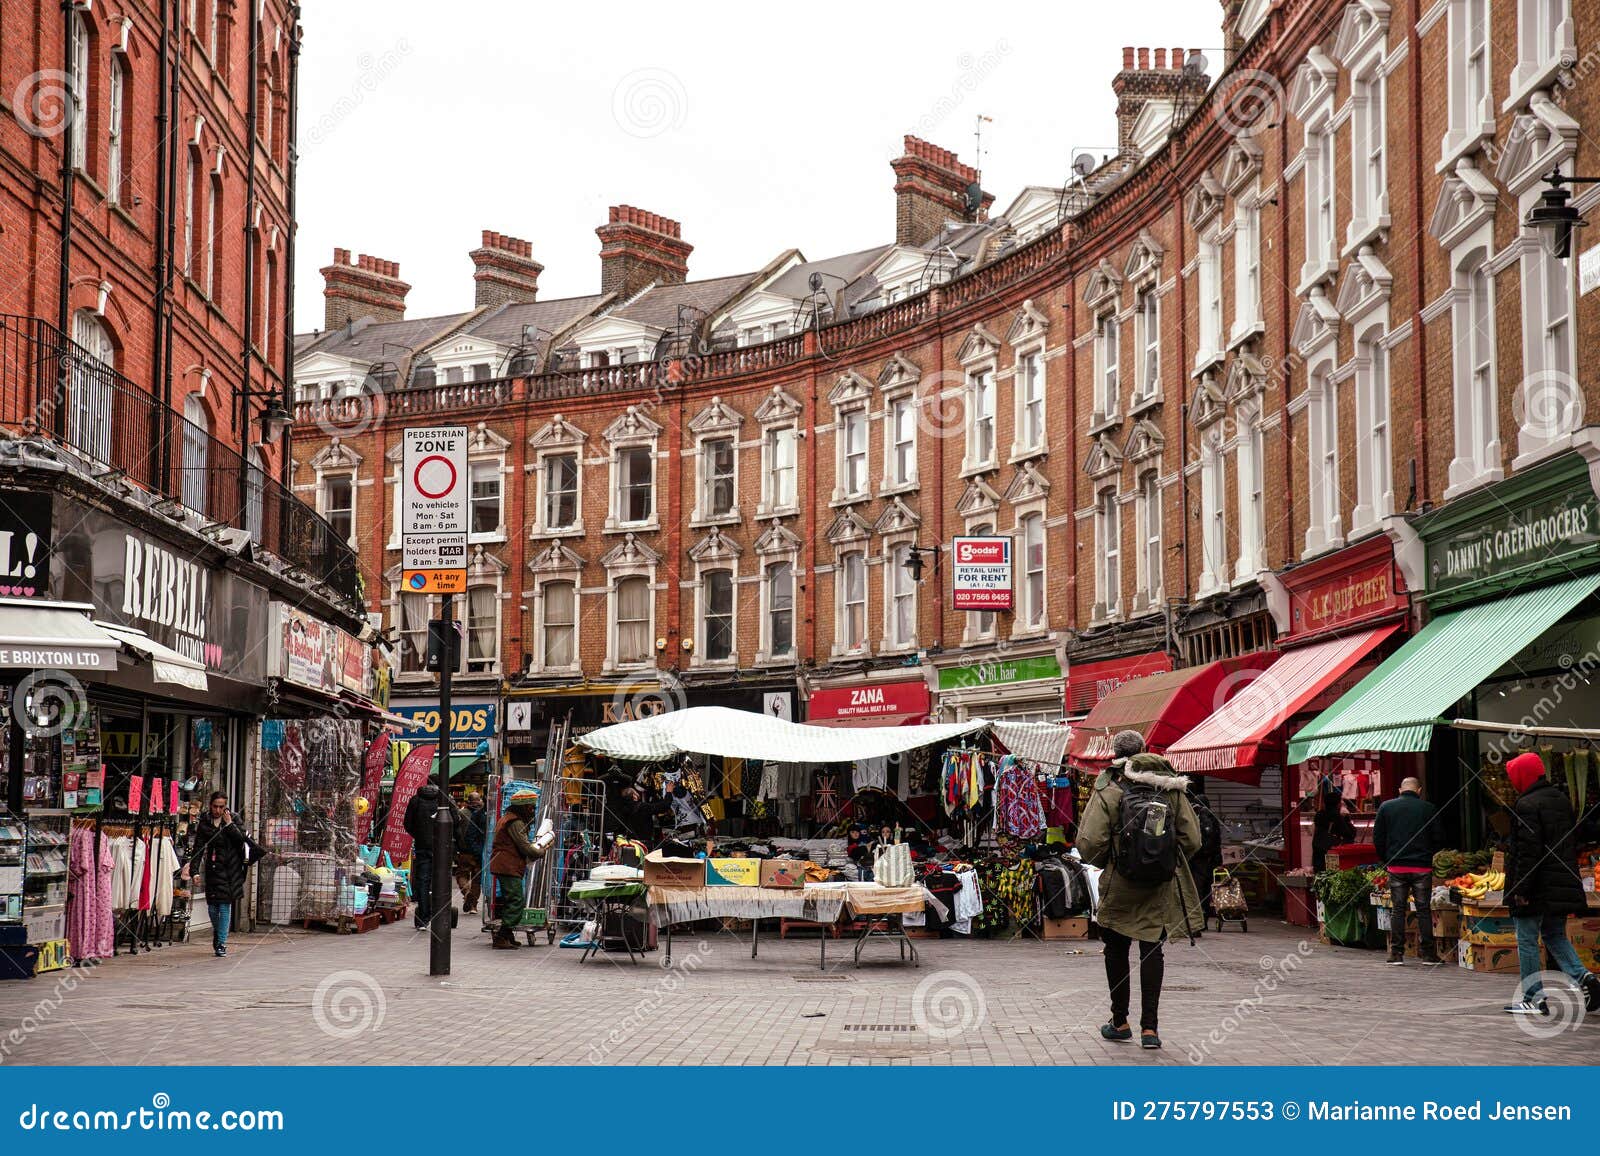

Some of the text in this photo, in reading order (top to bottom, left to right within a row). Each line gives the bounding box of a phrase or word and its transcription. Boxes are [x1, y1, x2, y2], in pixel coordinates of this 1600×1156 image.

[407, 430, 464, 439] PEDESTRIAN
[415, 440, 456, 452] ZONE
[406, 536, 464, 546] Except permit
[1446, 504, 1588, 577] DANNY'S GREENGROCERS
[406, 547, 437, 555] holders
[960, 544, 999, 560] goodsir
[445, 574, 460, 582] any
[122, 534, 208, 640] REBEL!
[1334, 576, 1388, 613] BUTCHER
[175, 633, 205, 664] LONDON
[12, 651, 75, 666] BRIXTON
[77, 652, 100, 666] LTD
[1000, 666, 1017, 680] hair
[851, 688, 884, 705] ZANA
[838, 707, 855, 715] QUALITY
[856, 706, 870, 714] HALAL
